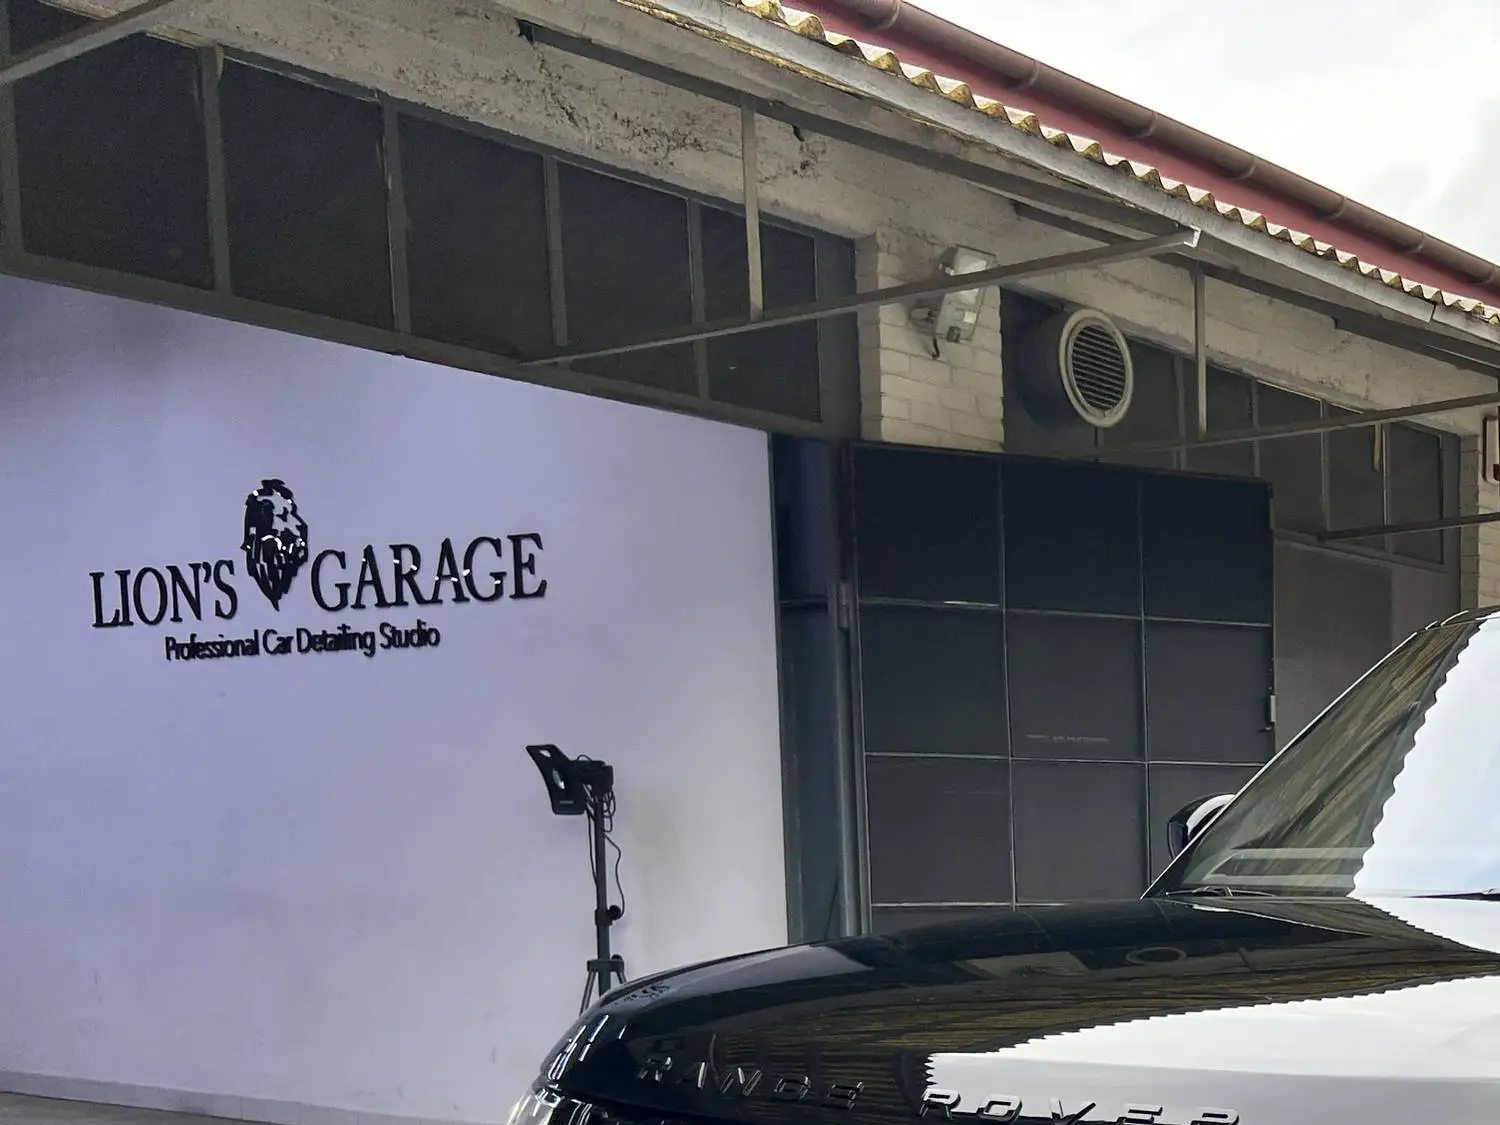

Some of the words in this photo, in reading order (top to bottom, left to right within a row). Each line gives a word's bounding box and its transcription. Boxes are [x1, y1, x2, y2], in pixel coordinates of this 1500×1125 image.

[89, 559, 237, 628] LION'S
[310, 533, 548, 612] GARAGE
[164, 629, 260, 661] Professional
[262, 628, 295, 655] Car
[296, 624, 376, 658] Detailing
[379, 619, 441, 649] Studio
